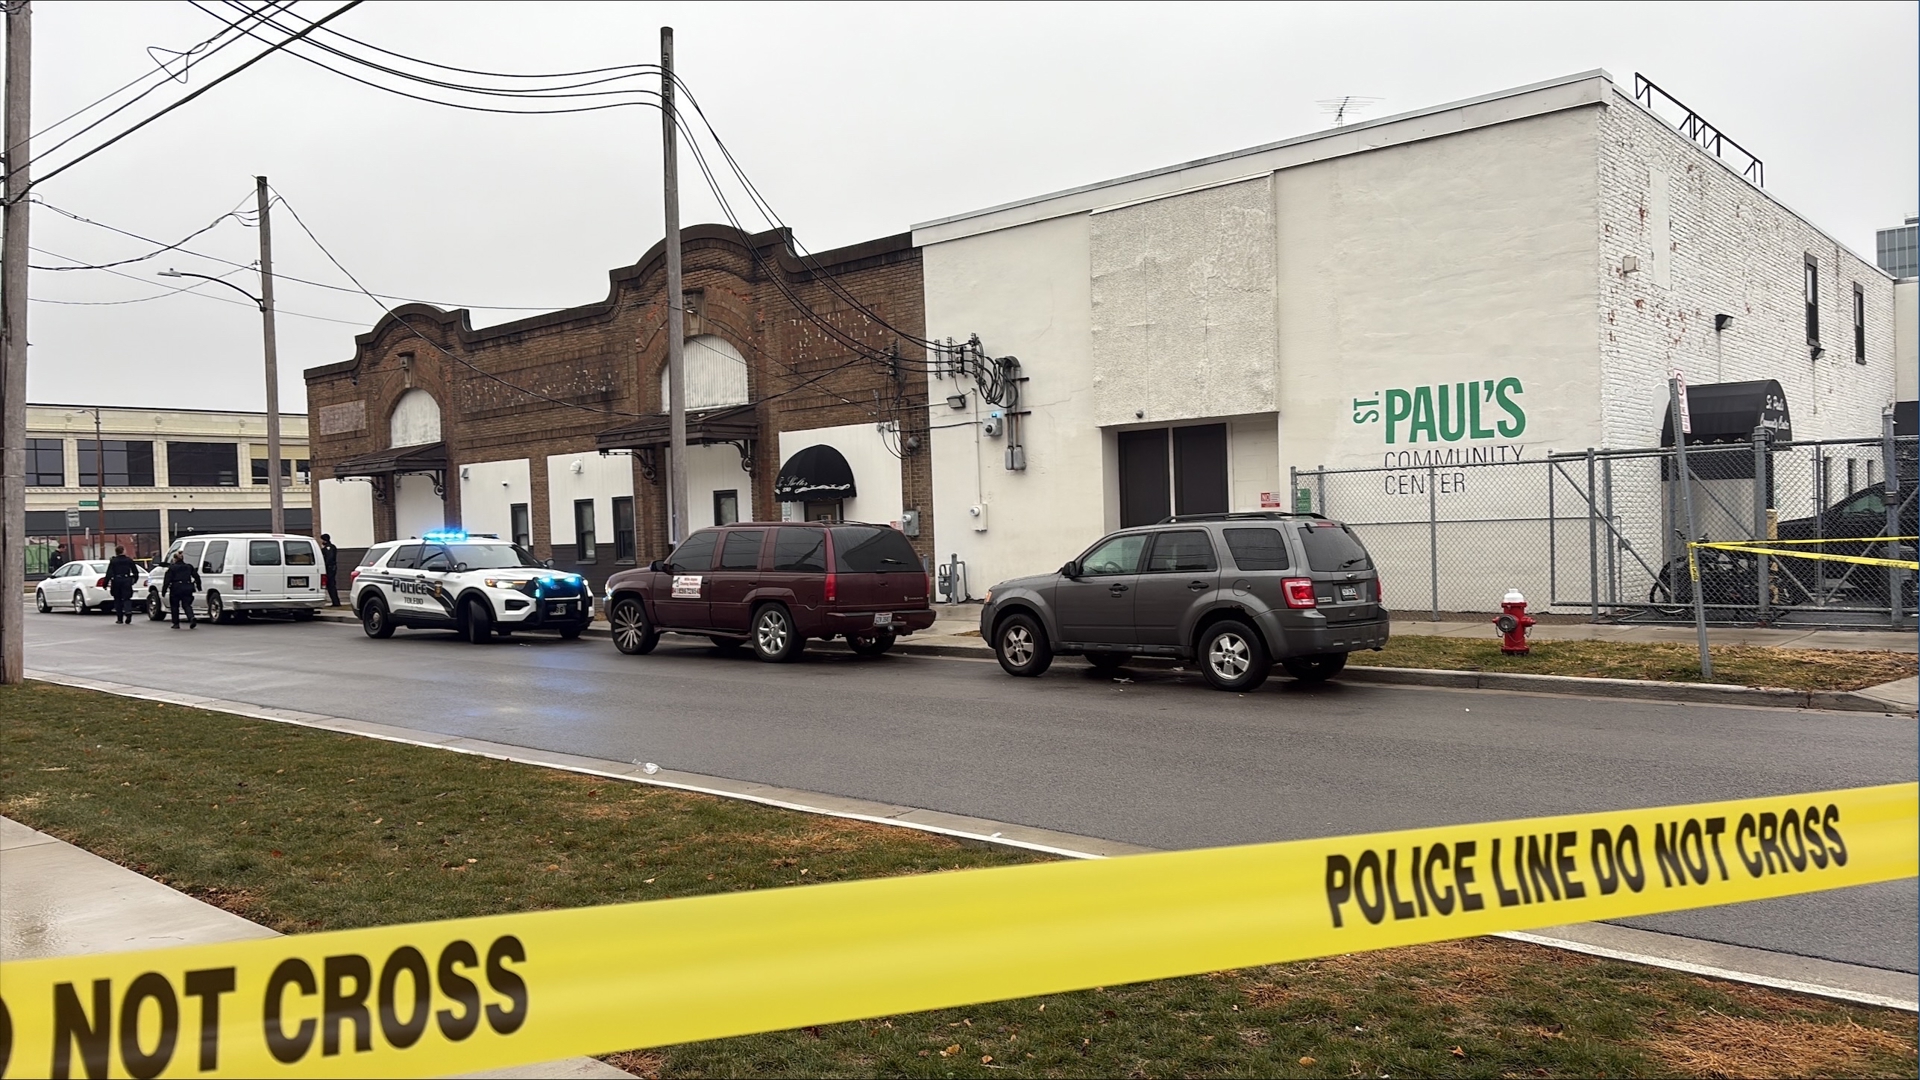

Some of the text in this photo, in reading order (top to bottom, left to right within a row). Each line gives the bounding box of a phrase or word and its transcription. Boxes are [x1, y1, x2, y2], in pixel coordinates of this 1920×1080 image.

[1353, 376, 1526, 444] ST. PAUL'S
[1384, 445, 1524, 468] COMMUNITY
[392, 578, 428, 595] POLICE
[403, 596, 424, 605] TOLEDO
[1325, 803, 1849, 928] POLICE LINE DO NOT CROSS
[49, 965, 237, 1079] NOT
[262, 934, 530, 1065] CROSS
